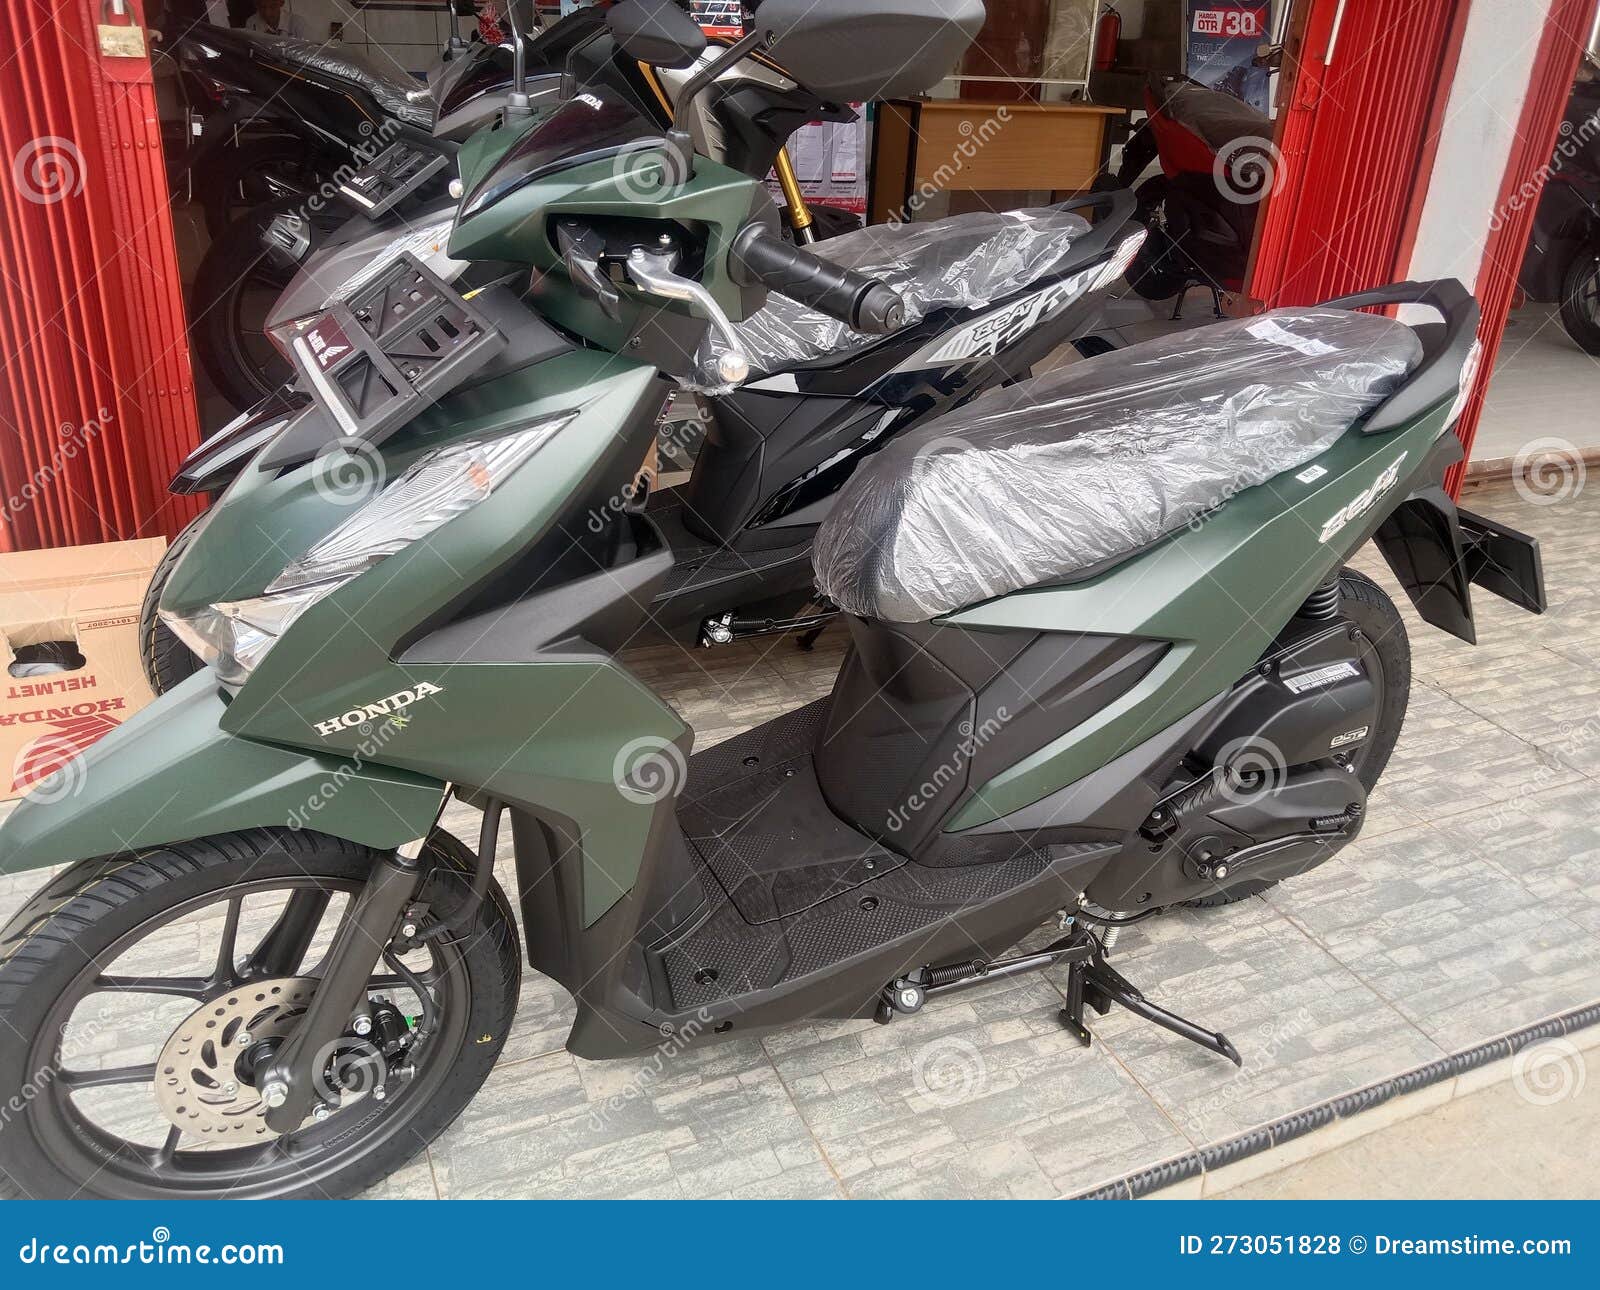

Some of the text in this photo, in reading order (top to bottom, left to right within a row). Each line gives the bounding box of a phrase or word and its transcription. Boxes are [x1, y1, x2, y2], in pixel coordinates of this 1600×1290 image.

[1198, 20, 1218, 31] OTR
[1225, 11, 1256, 36] 30
[7, 675, 97, 699] HELMET
[313, 681, 443, 737] HONDA
